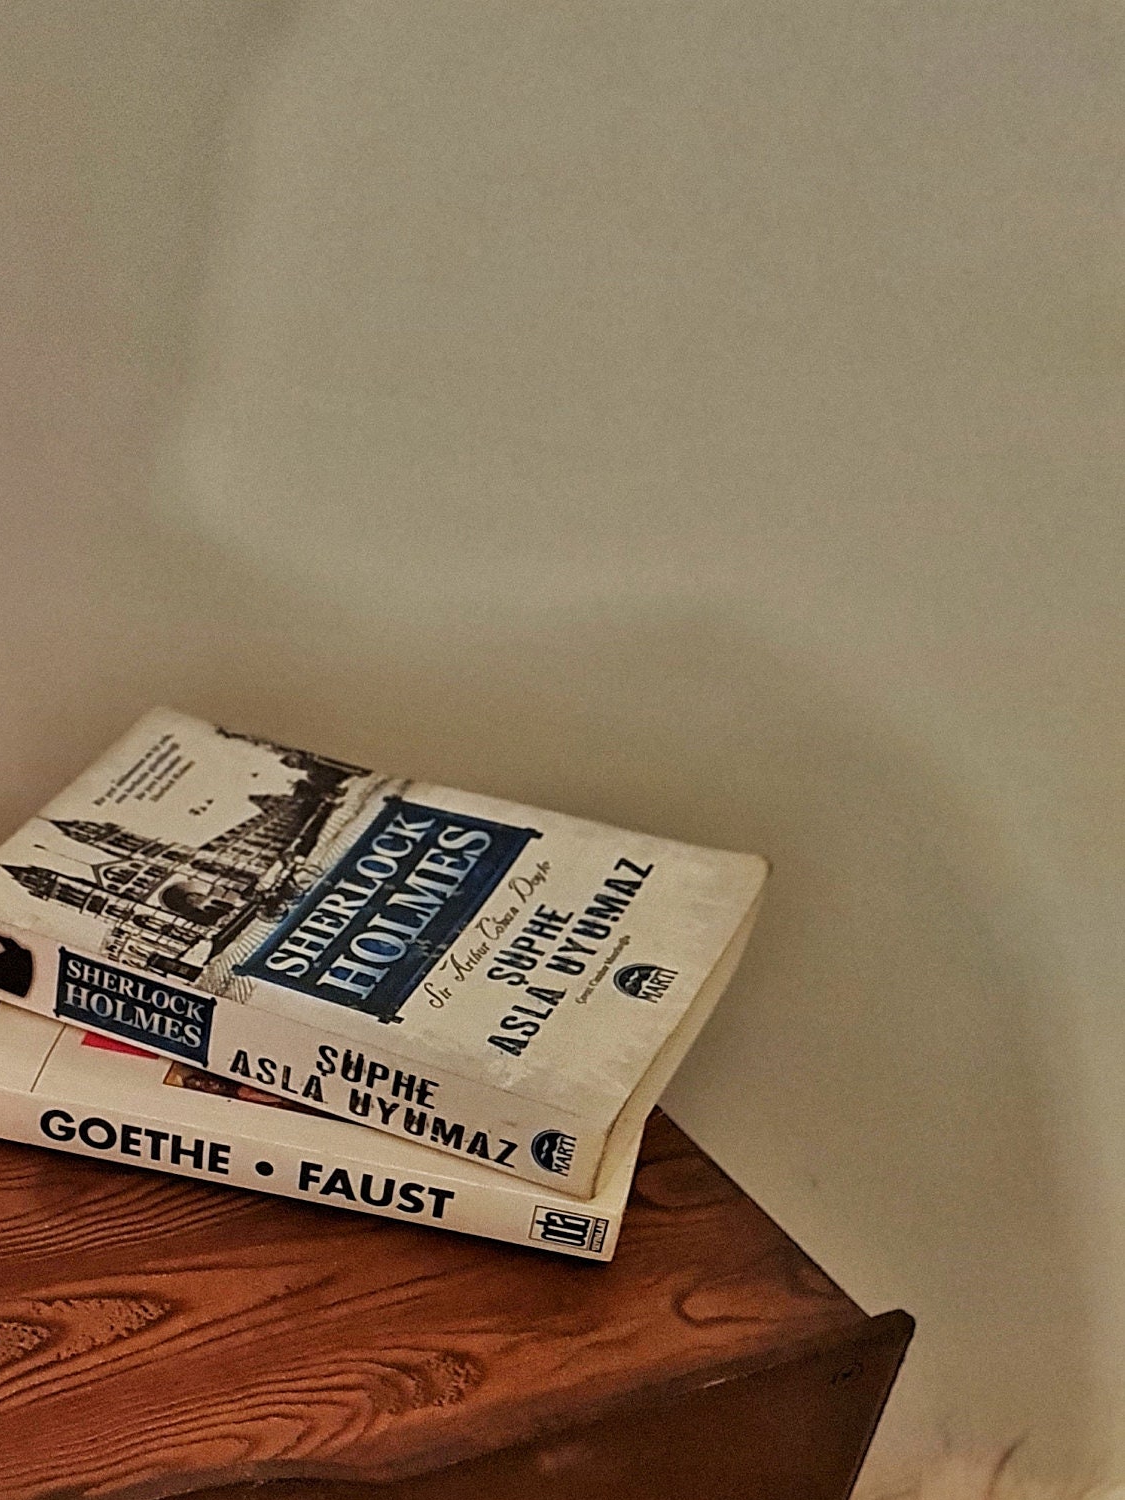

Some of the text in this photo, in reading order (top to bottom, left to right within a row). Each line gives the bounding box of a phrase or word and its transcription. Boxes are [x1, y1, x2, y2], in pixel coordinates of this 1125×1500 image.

[265, 812, 436, 979] SHERLOCK
[316, 825, 492, 1001] HOLMES
[66, 958, 205, 1023] SHERLOCK
[424, 981, 453, 1009] Sir
[439, 942, 490, 982] Arthur
[487, 982, 568, 1057] ASLA
[545, 857, 654, 976] UYUMAZ
[637, 966, 679, 1003] MARTI
[63, 981, 203, 1049] HOLMES
[229, 1049, 519, 1168] ASLA UYUMAZ
[39, 1109, 455, 1219] GOETHE FAUST
